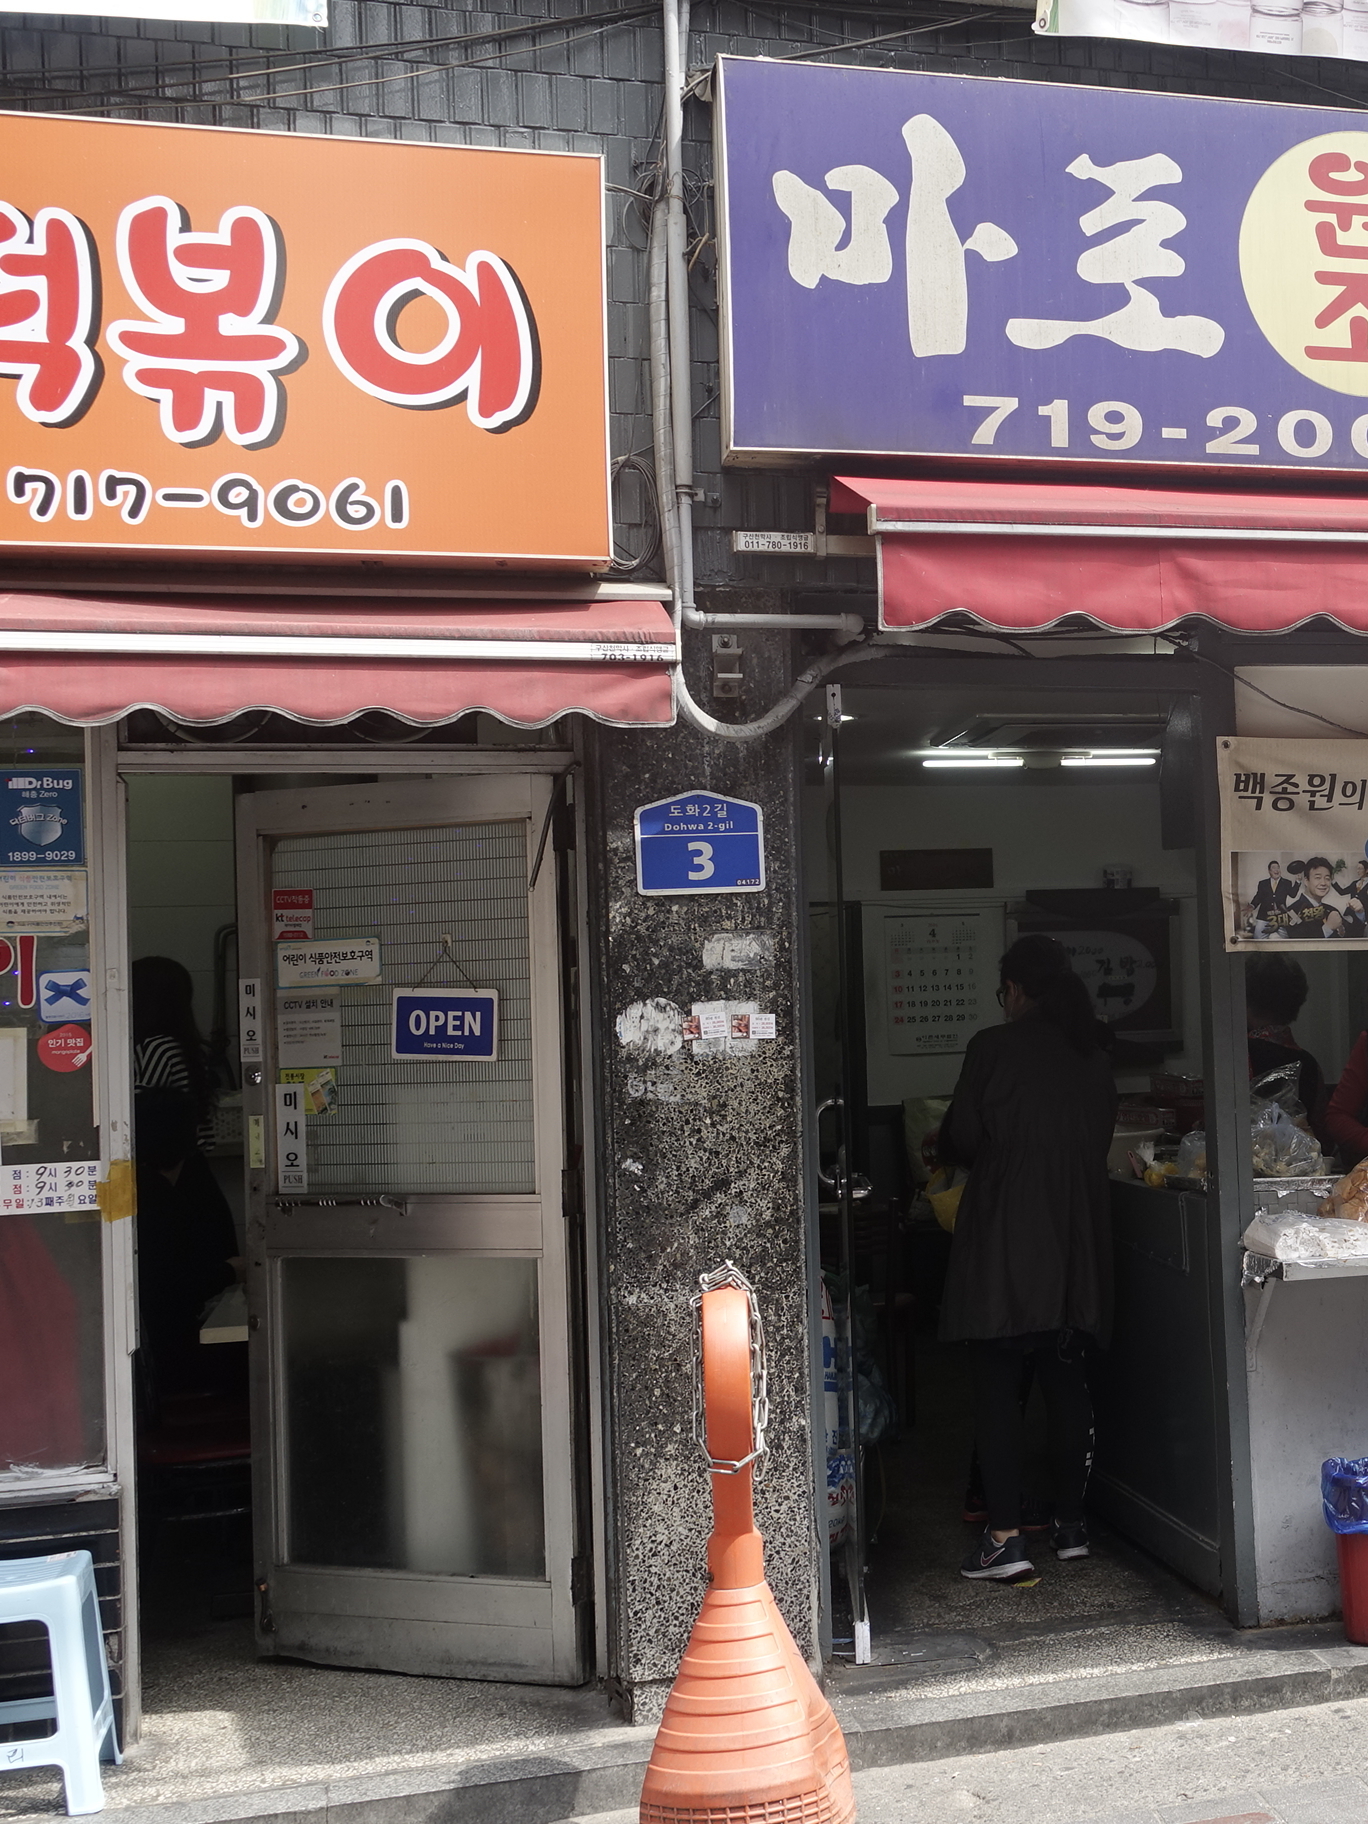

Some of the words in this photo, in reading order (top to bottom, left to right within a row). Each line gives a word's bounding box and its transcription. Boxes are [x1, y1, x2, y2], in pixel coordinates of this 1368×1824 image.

[7, 464, 410, 530] 717-9061
[744, 540, 809, 550] 011-780-1916
[601, 653, 664, 662] 703-1916
[1232, 772, 1368, 813] 백종원의
[668, 803, 728, 818] 도화2길
[46, 813, 69, 826] Zone
[664, 822, 705, 831] Dohwa
[706, 820, 734, 831] 2-gil
[8, 851, 76, 861] 1899-9029
[687, 841, 716, 881] 3
[275, 913, 285, 923] kt
[928, 927, 937, 939] 4
[282, 953, 307, 967] 어린이
[308, 949, 374, 965] 식품안전보호구역
[956, 953, 961, 961] 1
[299, 970, 320, 979] GREEN
[321, 967, 340, 978] FOOD
[341, 967, 359, 977] ZONE
[907, 969, 913, 977] 4
[944, 968, 950, 976] 7
[956, 968, 963, 976] 8
[894, 985, 904, 993] 10
[919, 984, 928, 992] 12
[931, 984, 940, 992] 13
[956, 983, 965, 991] 15
[284, 1000, 303, 1010] CCTV
[304, 1000, 319, 1010] 설치
[320, 998, 334, 1009] 안내
[894, 1000, 904, 1008] 17
[931, 999, 941, 1007] 20
[955, 998, 965, 1006] 22
[245, 983, 257, 1042] 미시오
[408, 1009, 481, 1036] OPEN
[894, 1015, 905, 1024] 24
[906, 1015, 917, 1023] 25
[919, 1014, 929, 1022] 26
[931, 1014, 941, 1022] 27
[956, 1013, 966, 1021] 29
[47, 1038, 65, 1048] 인기
[66, 1037, 84, 1047] 맛집
[423, 1041, 437, 1049] Have
[441, 1041, 454, 1049] Nice
[454, 1041, 465, 1050] Day
[243, 1046, 260, 1055] PUSH
[283, 1090, 301, 1168] 미시오
[283, 1173, 303, 1184] PUSH
